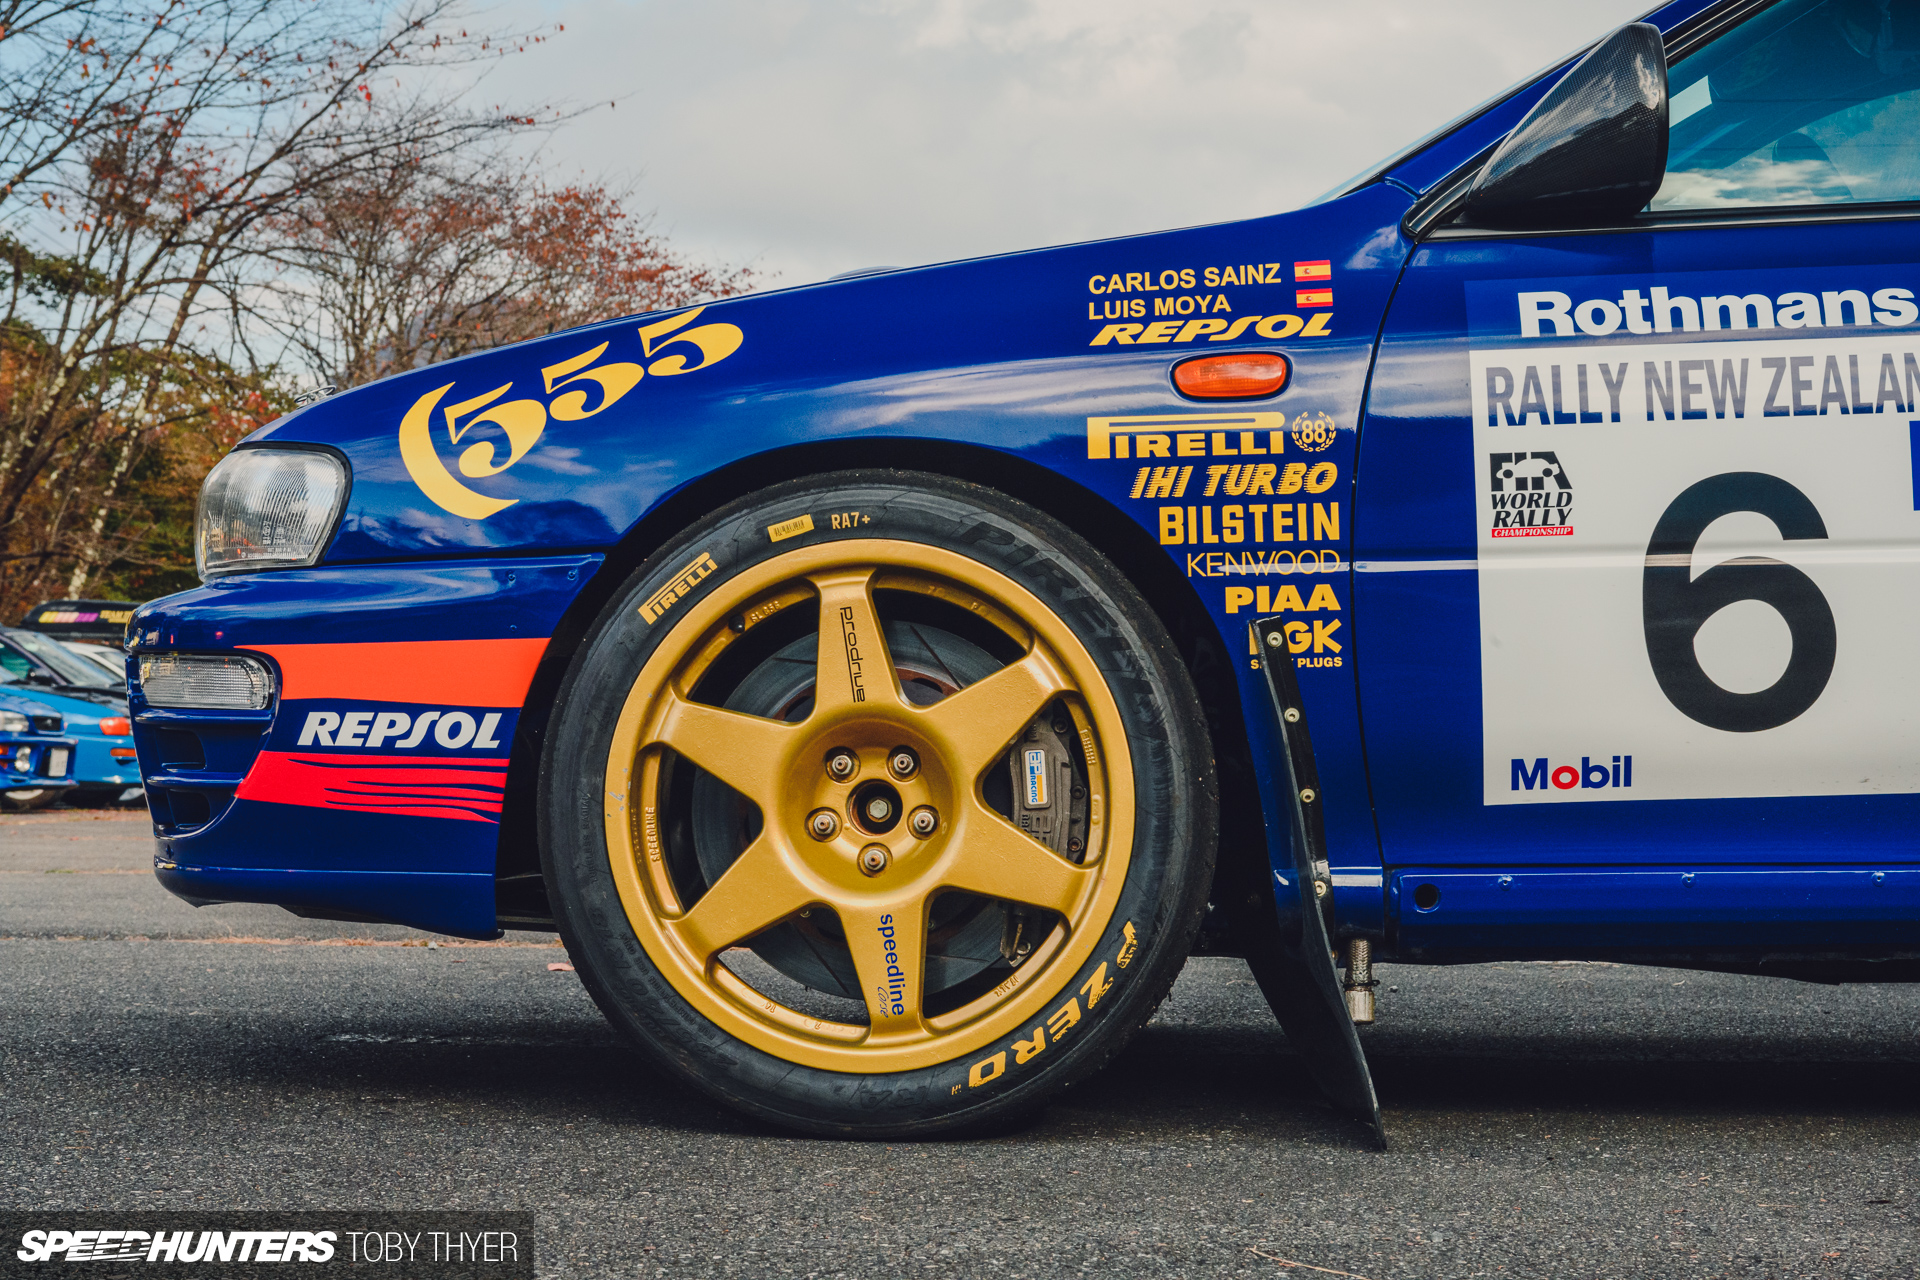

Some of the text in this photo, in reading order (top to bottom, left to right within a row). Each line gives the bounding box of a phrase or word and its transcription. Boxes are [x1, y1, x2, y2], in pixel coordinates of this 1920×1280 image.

[1089, 263, 1282, 295] CARLOS SAINZ
[1089, 294, 1232, 320] LUIS MOYA
[1518, 287, 1919, 338] Rothmans
[1089, 312, 1334, 346] REPSOL
[444, 306, 744, 479] 555
[1485, 362, 1629, 427] RALLY
[1644, 358, 1750, 422] NEW
[1087, 412, 1326, 460] PIRELLI 88
[1129, 462, 1338, 499] IHI TURBO
[1491, 492, 1573, 510] WORLD
[1493, 508, 1573, 528] RALLY
[831, 512, 871, 530] RA7+
[1159, 502, 1340, 545] BILSTEIN
[1494, 528, 1571, 537] CHAMPIONSHIP
[1187, 550, 1340, 577] KENWOOD
[638, 552, 718, 625] PIRELLI
[1225, 584, 1341, 613] PIAA
[1643, 471, 1837, 733] 6
[1249, 618, 1342, 655] GK
[840, 606, 866, 704] prodrive
[1297, 656, 1343, 668] PLUGS
[297, 711, 503, 749] REPSOL
[1030, 775, 1038, 803] RACING
[1511, 755, 1632, 791] Mobil
[877, 914, 906, 1015] speedline
[877, 986, 889, 1018] Corse
[968, 961, 1114, 1088] ZERO
